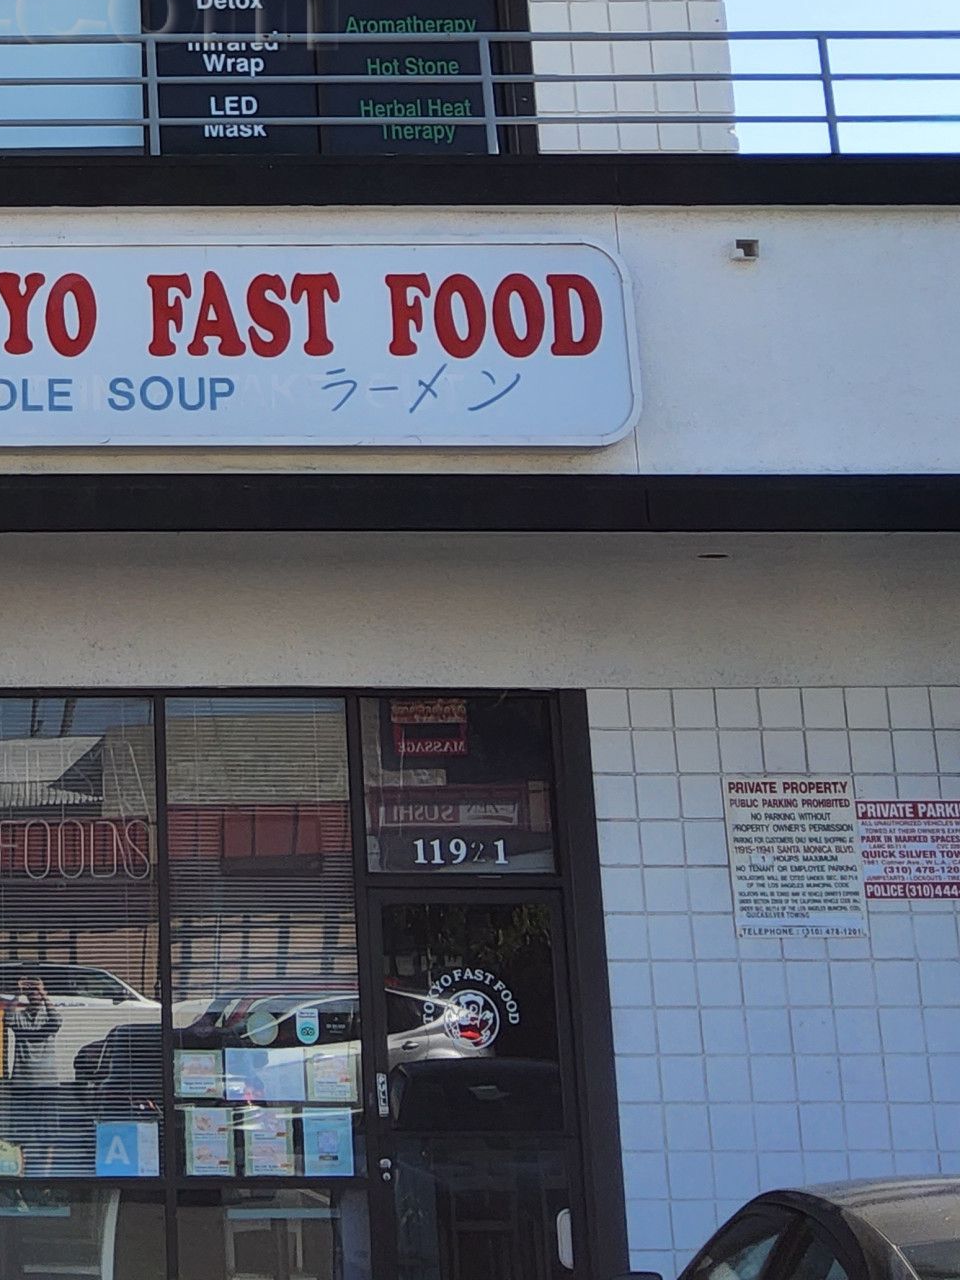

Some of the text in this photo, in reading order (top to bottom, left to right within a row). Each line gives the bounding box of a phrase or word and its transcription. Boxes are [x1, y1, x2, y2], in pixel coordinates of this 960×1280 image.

[346, 16, 477, 34] Aromatherapy
[202, 53, 265, 77] Wrap
[367, 57, 459, 76] Hot Stone
[210, 96, 258, 116] LED
[360, 98, 472, 118] Herbal Heat
[204, 122, 267, 138] Mask
[381, 121, 456, 144] Therapy
[146, 270, 340, 358] FAST
[384, 272, 603, 359] FOOD
[107, 375, 235, 412] SOUP
[321, 363, 521, 414] ラーメン
[728, 781, 848, 794] PRIVATE PROPERTY
[730, 798, 851, 808] PUBLIC PARKING PROHIBITED
[857, 803, 914, 817] PRIVATE
[751, 812, 831, 820] NO PARKING WITHOUT
[732, 823, 853, 832] PROPERTY OWNER'S PERMISSION
[860, 835, 960, 843] PARK IN MARKED SPACES
[413, 838, 508, 864] 11921
[777, 845, 800, 854] SANTA
[803, 845, 832, 854] MONICA
[862, 850, 896, 859] QUICK
[899, 850, 936, 859] SILVER
[736, 864, 857, 872] NO TENANT OR EMPLOYEE PARKING
[884, 866, 912, 875] (310)
[866, 884, 905, 897] POLICE
[452, 967, 495, 985] FAST
[493, 980, 520, 1024] FOOD
[104, 1135, 130, 1165] A
